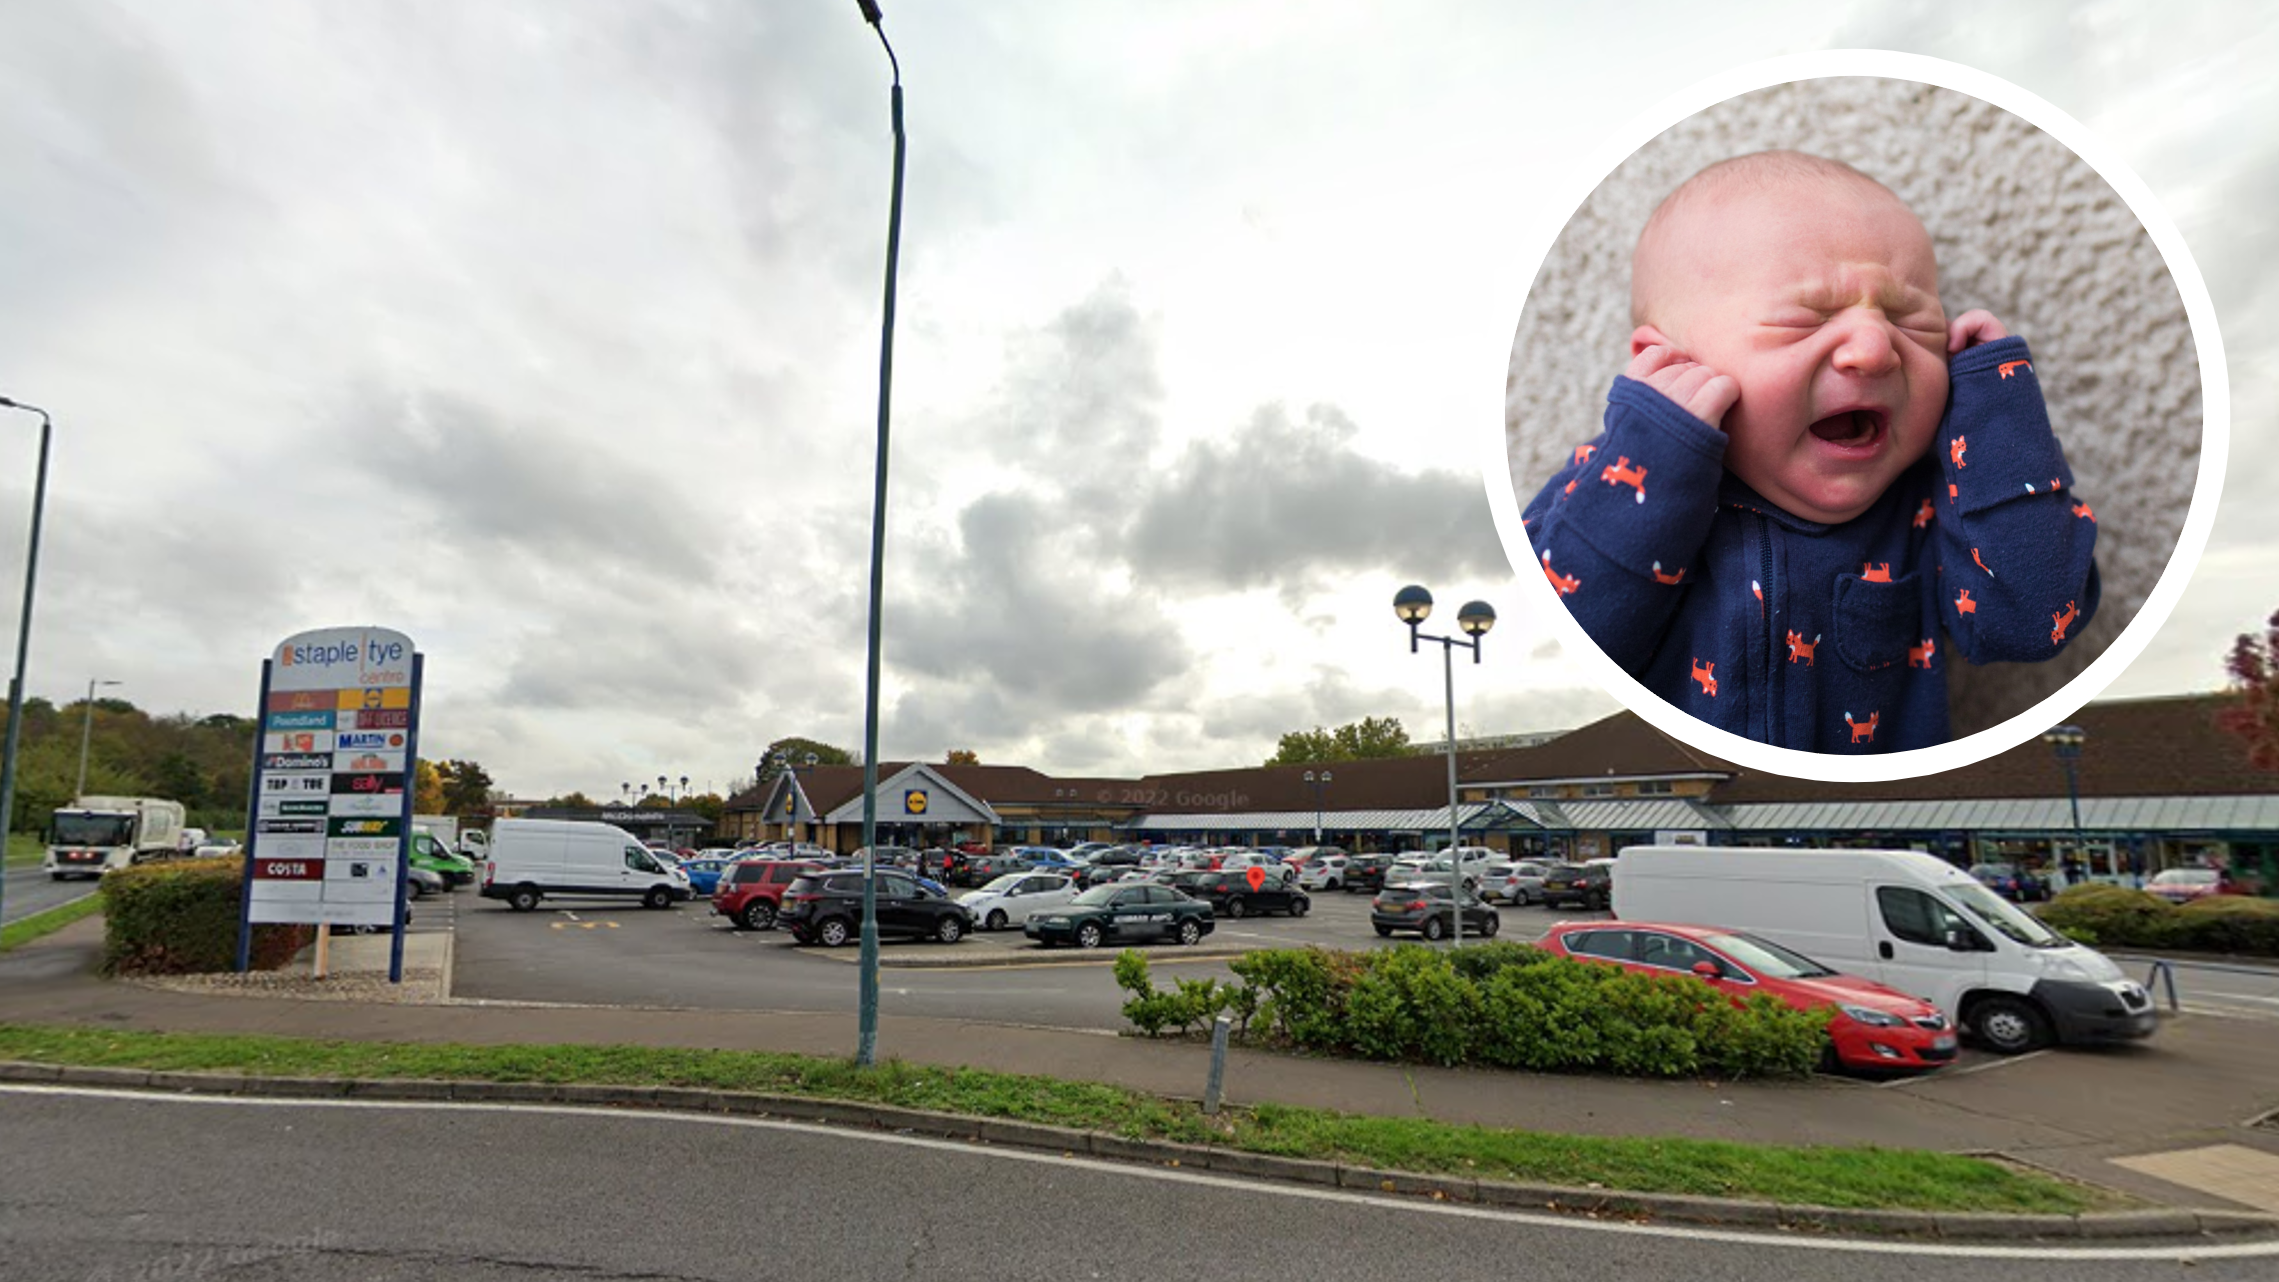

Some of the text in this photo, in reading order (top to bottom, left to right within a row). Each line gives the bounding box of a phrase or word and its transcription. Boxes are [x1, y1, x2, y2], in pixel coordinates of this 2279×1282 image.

[293, 639, 404, 667] staple tye
[272, 715, 327, 727] Poundland
[339, 733, 386, 749] MARTIN
[266, 862, 307, 876] COSTA
